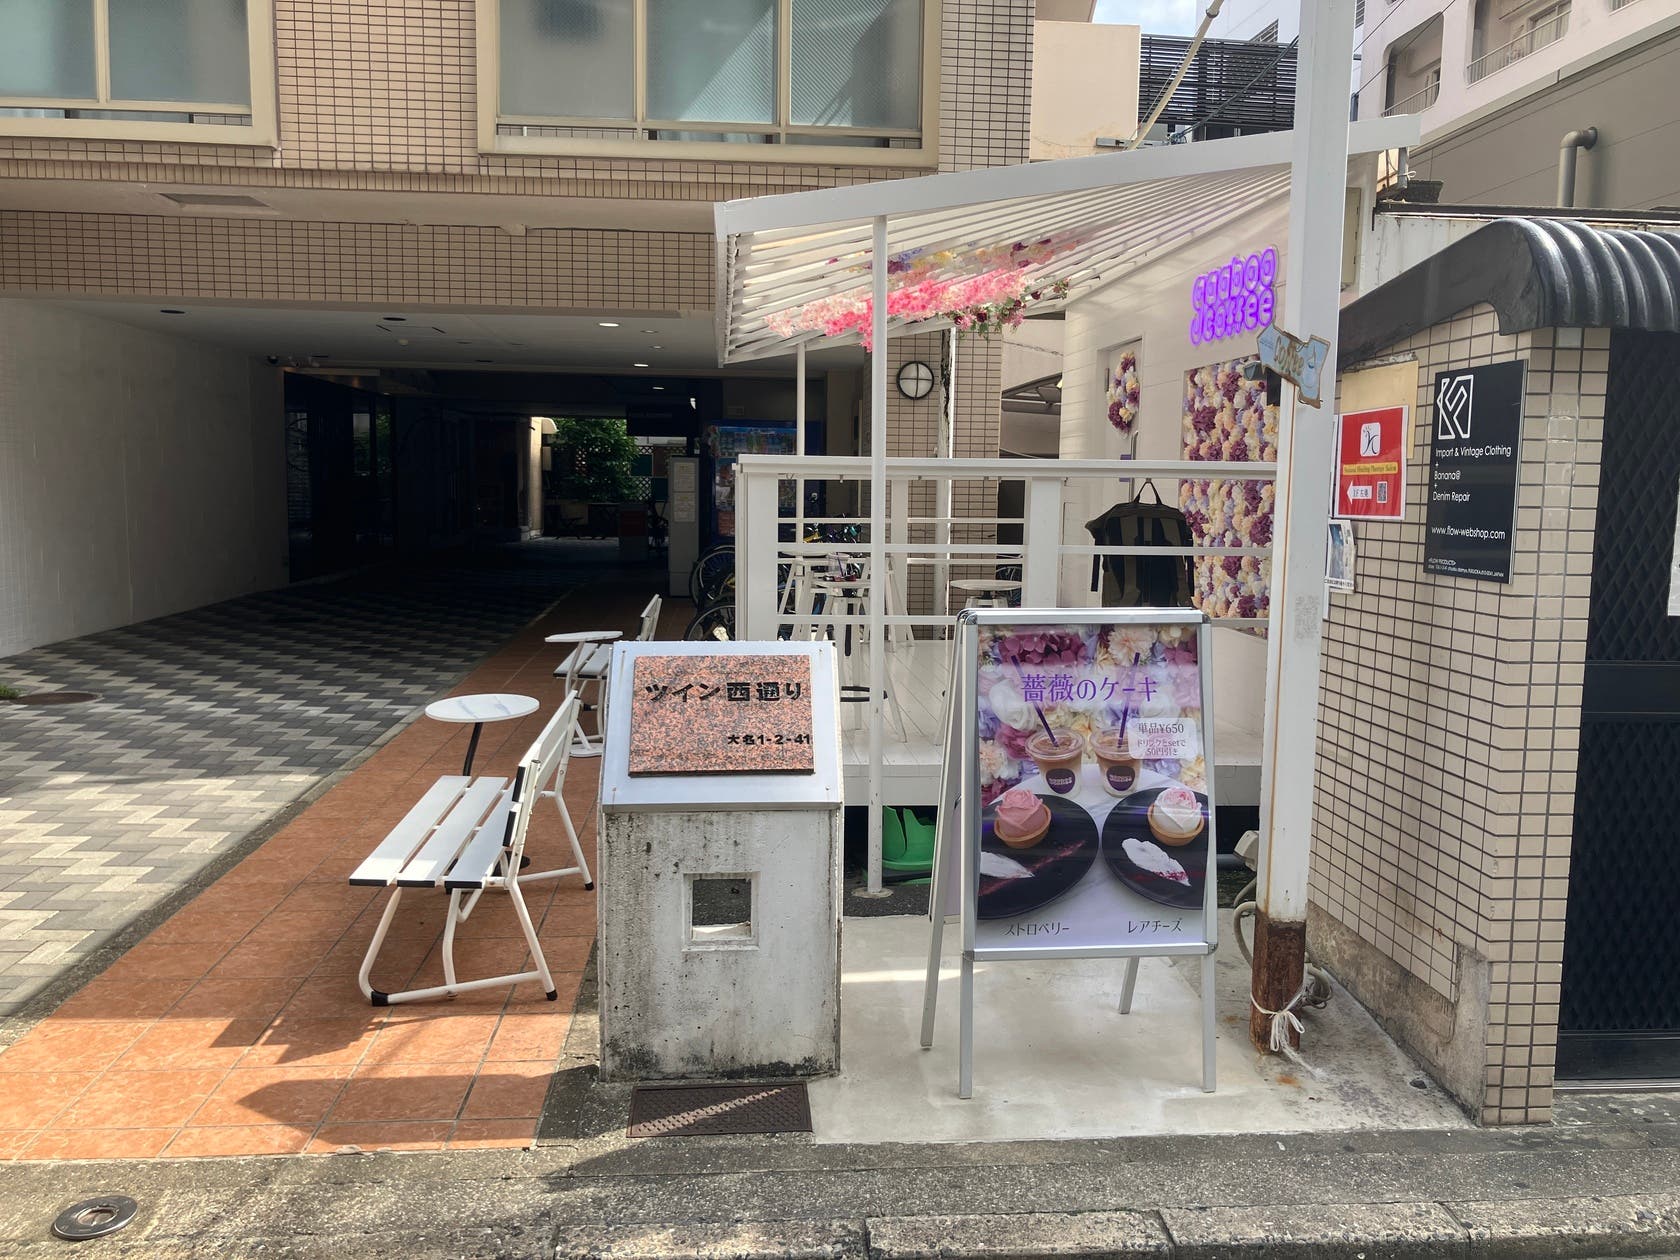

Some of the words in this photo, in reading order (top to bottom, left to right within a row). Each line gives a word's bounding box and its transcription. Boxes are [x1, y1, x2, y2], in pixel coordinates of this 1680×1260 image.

[1435, 447, 1454, 459] Import
[1454, 447, 1460, 457] &
[1460, 446, 1483, 458] Vintage
[1484, 445, 1512, 458] Clothing
[1433, 491, 1451, 501] Denim
[1451, 491, 1471, 503] Repair
[1431, 525, 1506, 540] www.flow-webshop.com
[645, 681, 801, 703] ツイン西通り
[1021, 673, 1158, 702] 薔薇のケーキ
[727, 733, 811, 745] 大名1-2-41
[1004, 921, 1070, 937] ストロベリー
[1127, 917, 1183, 934] レアチーズ
